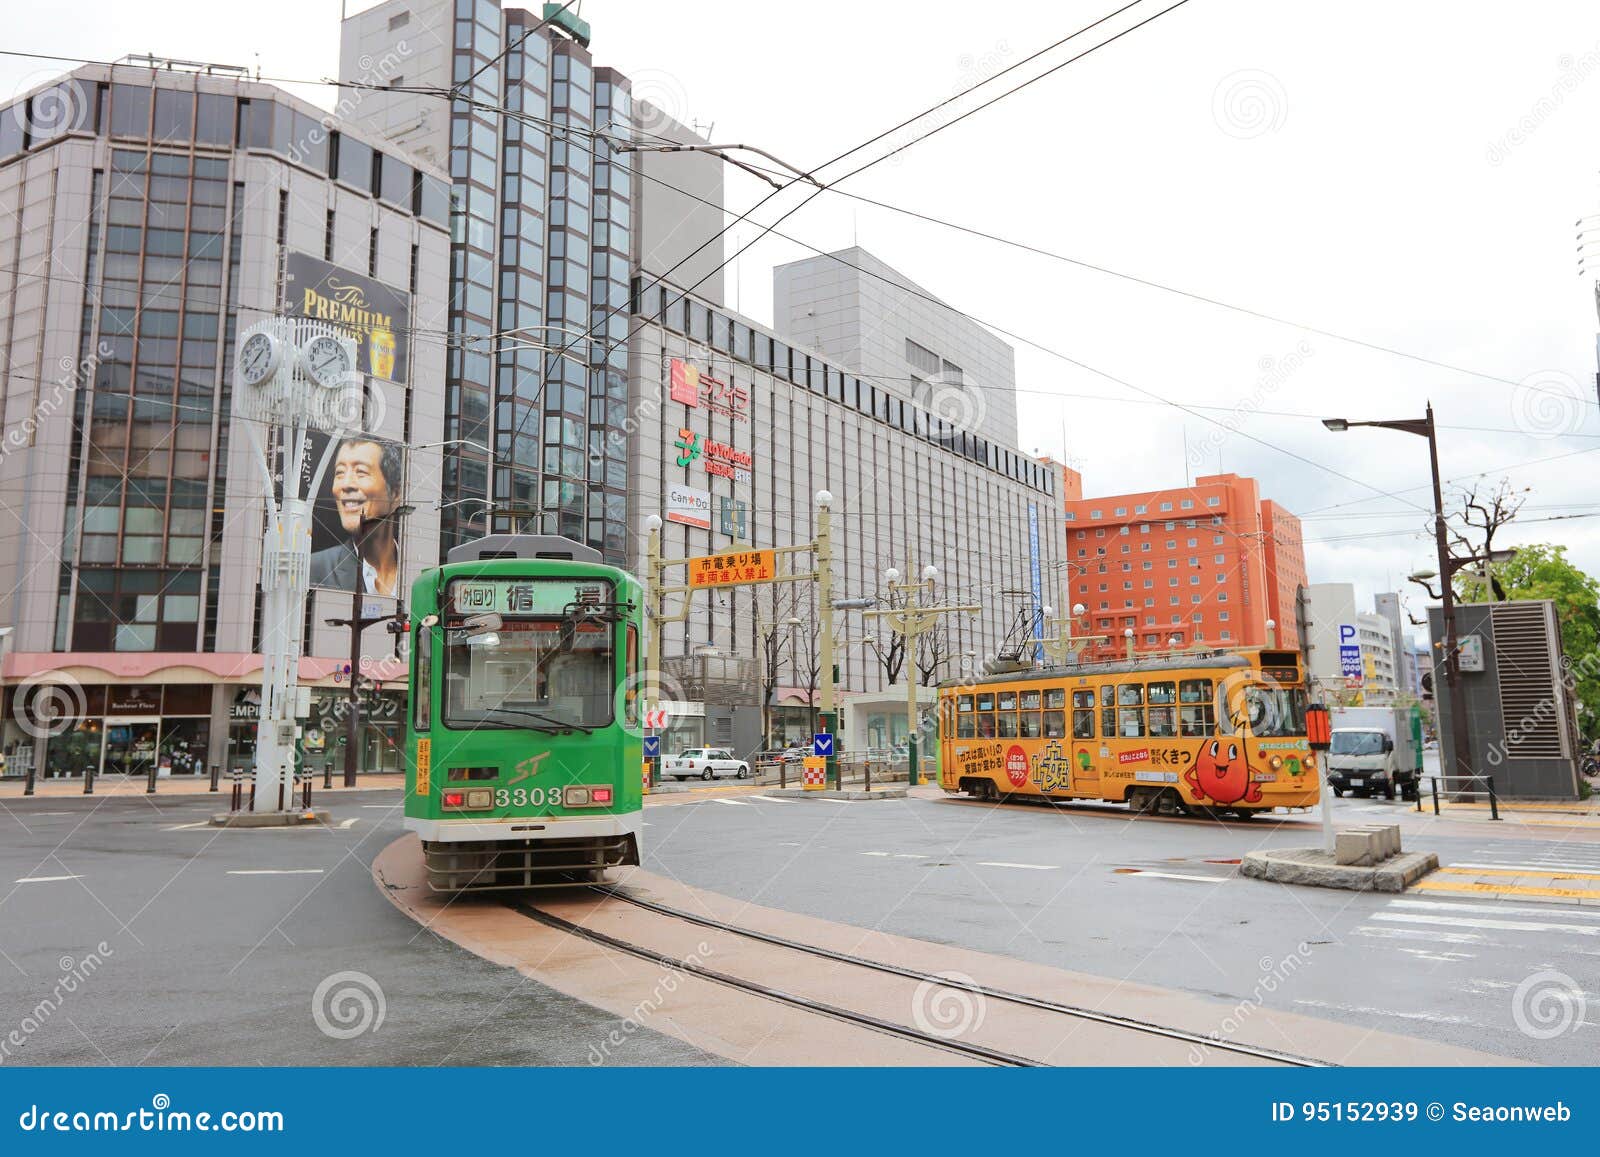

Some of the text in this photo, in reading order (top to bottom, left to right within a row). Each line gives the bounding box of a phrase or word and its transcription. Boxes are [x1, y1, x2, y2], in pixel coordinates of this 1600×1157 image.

[327, 276, 370, 308] The
[303, 287, 391, 334] PREMIUM
[701, 552, 761, 571] 市電乗り場
[695, 566, 769, 585] 車両進入禁止
[463, 586, 494, 606] 外回り
[1340, 625, 1355, 644] P
[1161, 748, 1191, 764] くきつ
[495, 787, 563, 807] 3303
